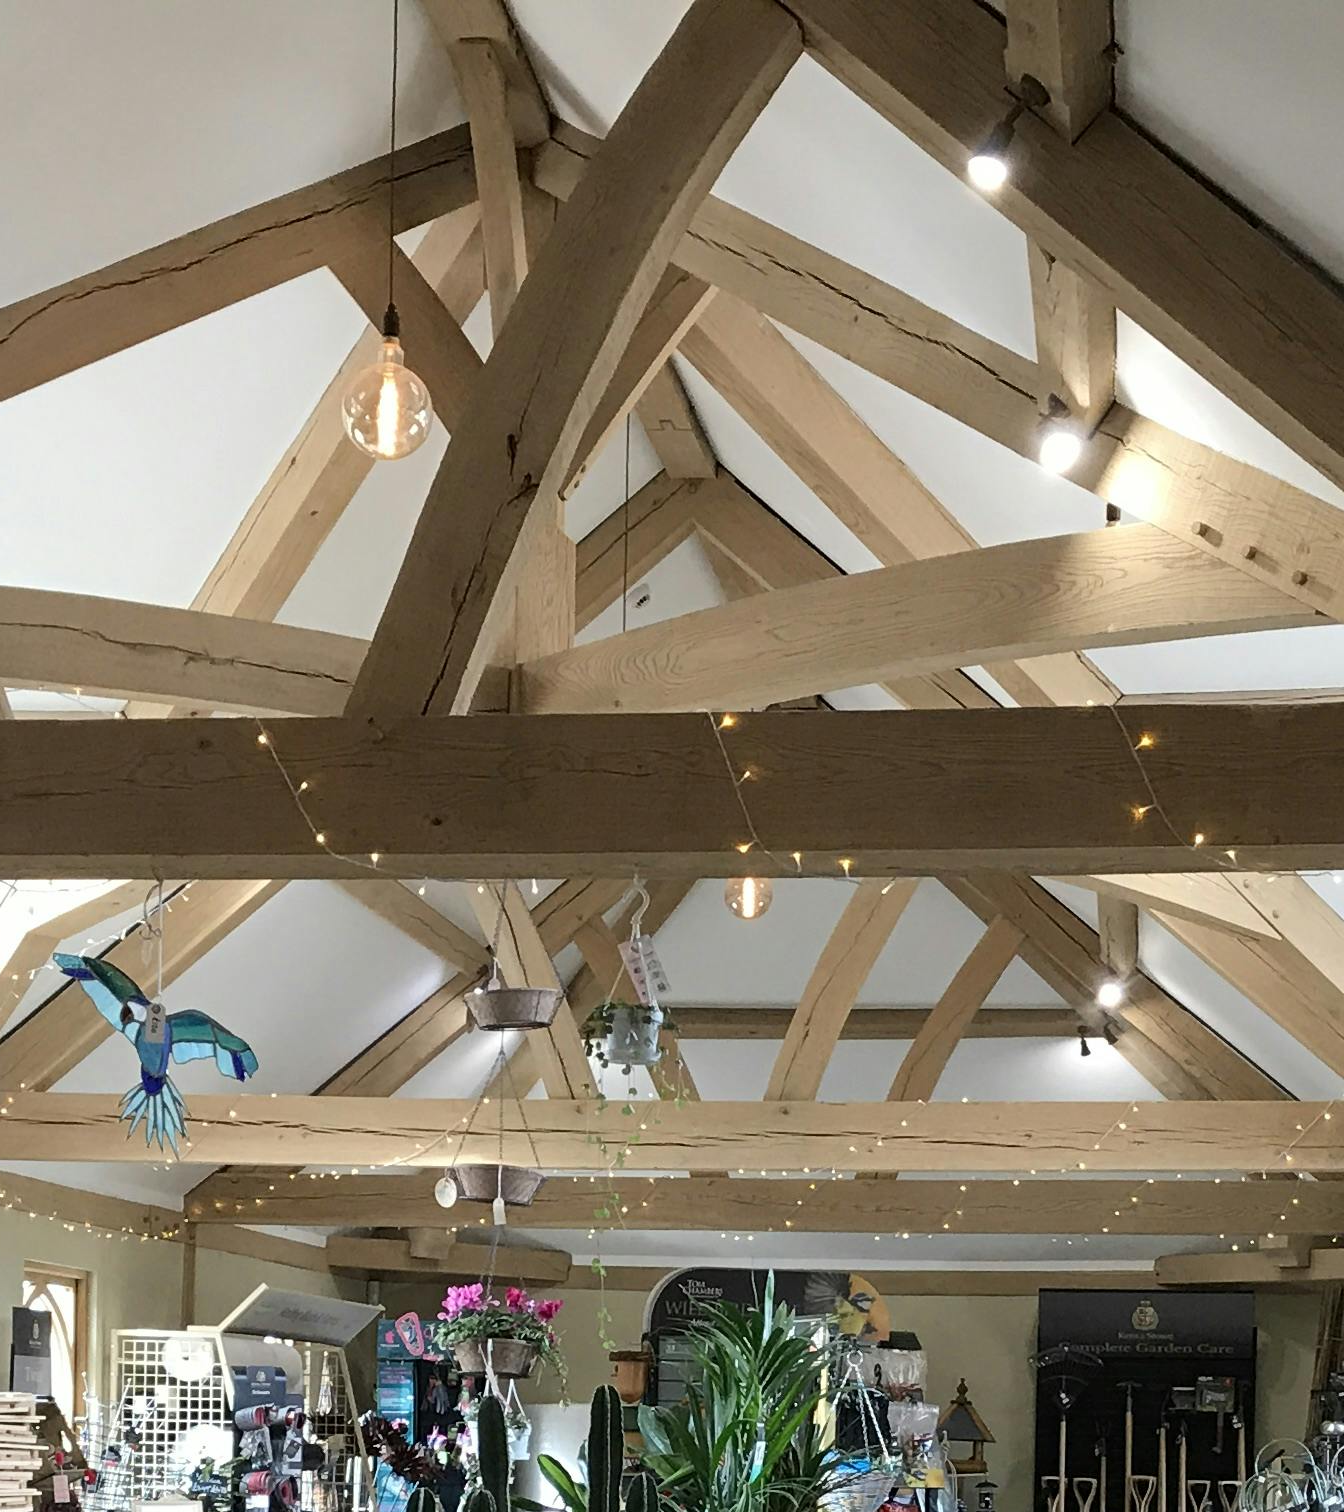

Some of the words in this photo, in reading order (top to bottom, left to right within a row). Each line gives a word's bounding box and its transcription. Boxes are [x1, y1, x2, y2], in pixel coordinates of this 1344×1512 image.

[1058, 1342, 1131, 1354] Complete
[1136, 1342, 1193, 1353] Garden
[1197, 1343, 1235, 1354] Care
